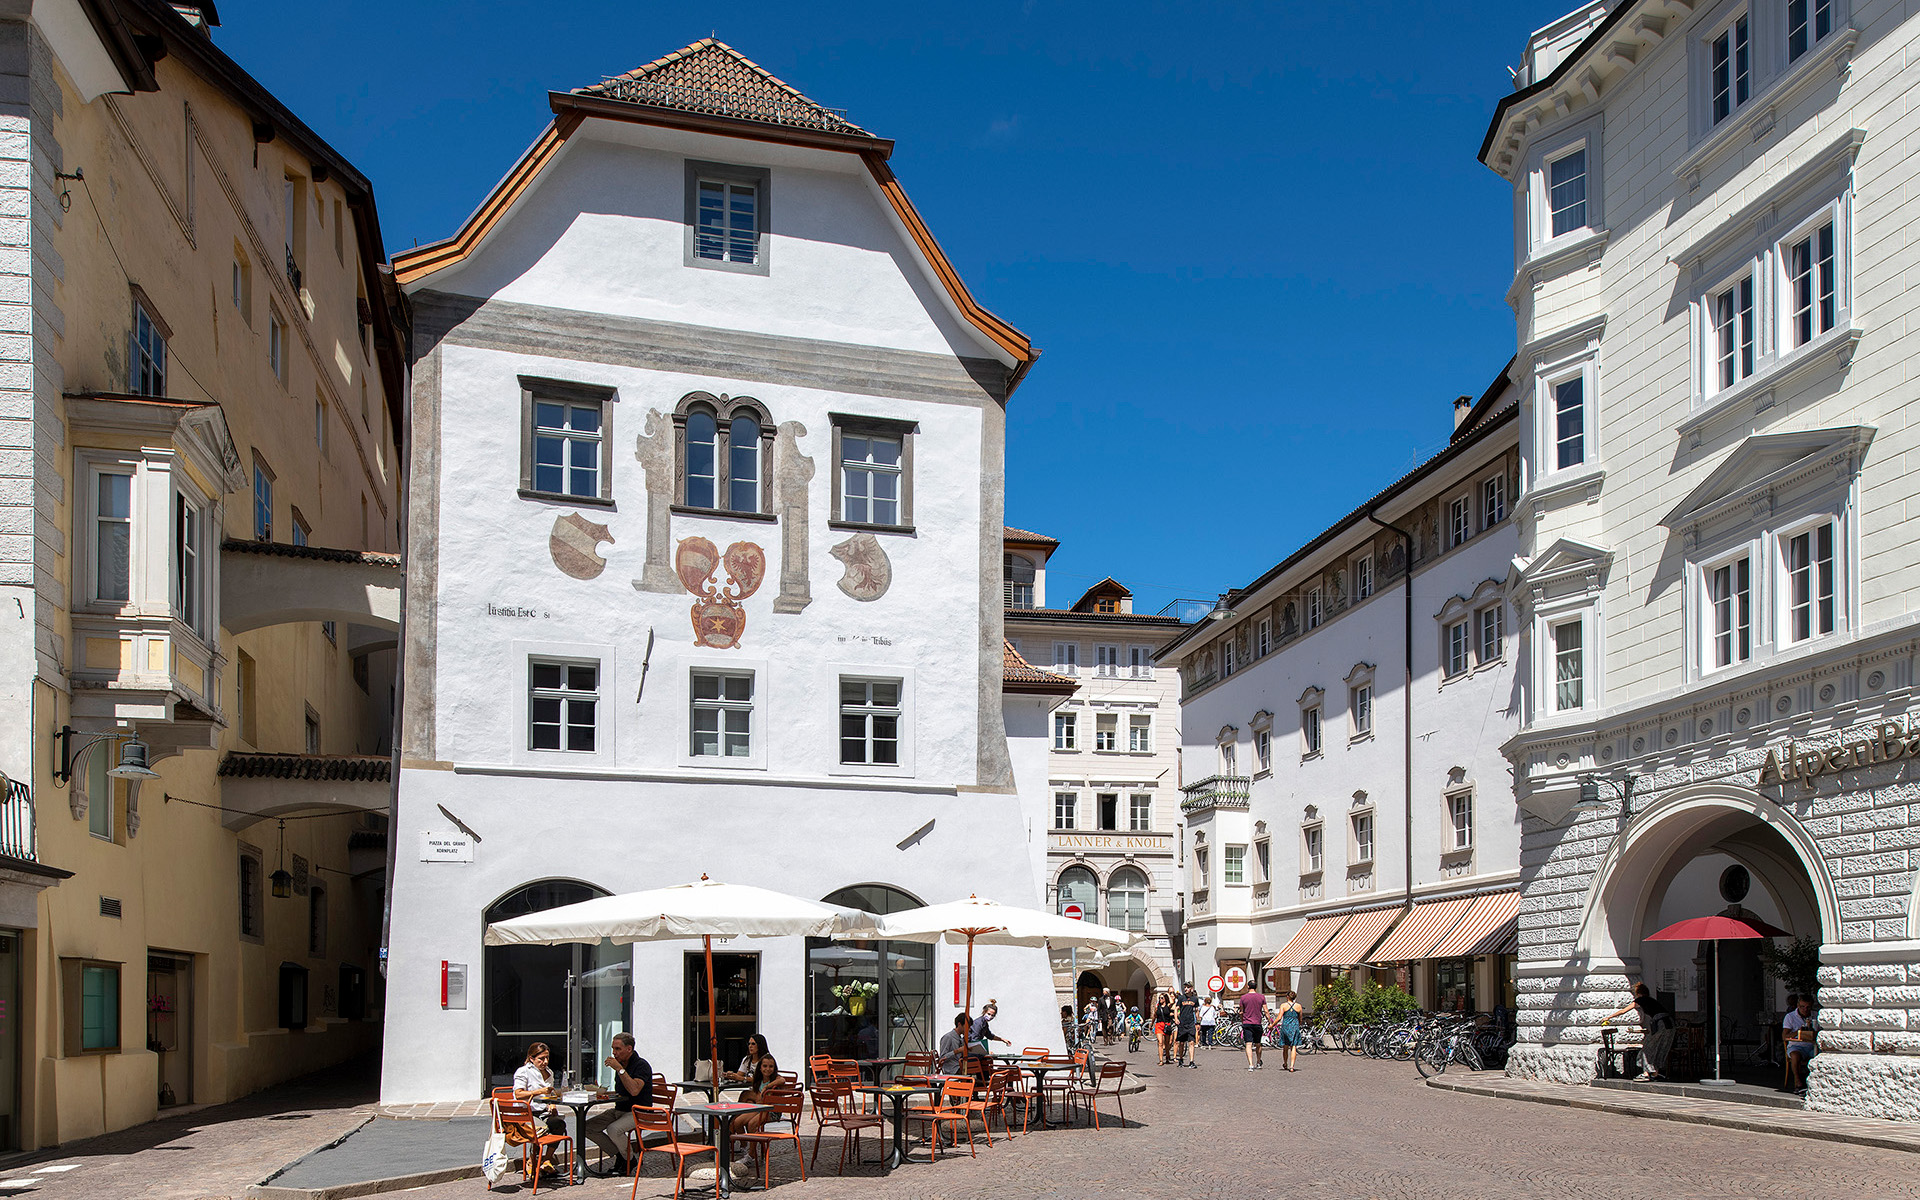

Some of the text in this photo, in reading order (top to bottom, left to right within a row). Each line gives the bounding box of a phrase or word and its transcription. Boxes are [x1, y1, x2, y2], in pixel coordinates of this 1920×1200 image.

[1058, 835, 1167, 849] LANNER & KNOLL
